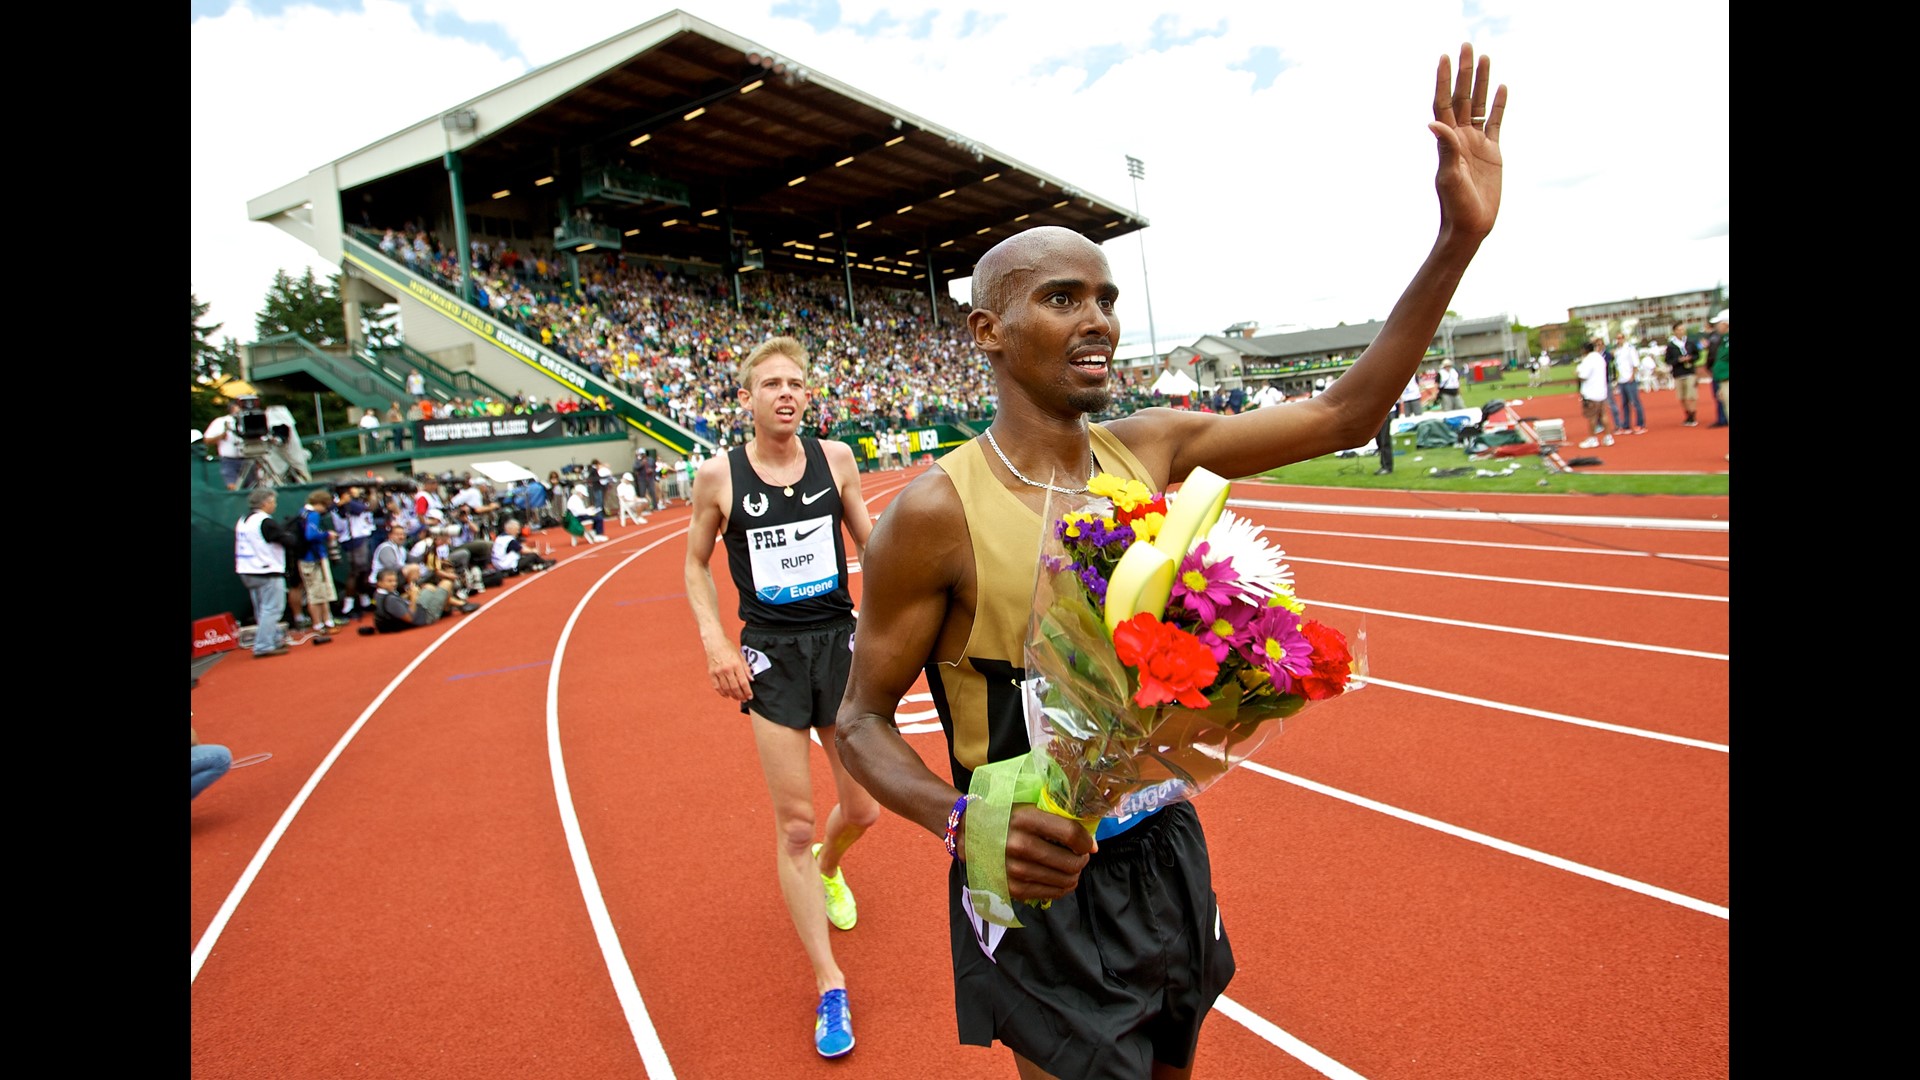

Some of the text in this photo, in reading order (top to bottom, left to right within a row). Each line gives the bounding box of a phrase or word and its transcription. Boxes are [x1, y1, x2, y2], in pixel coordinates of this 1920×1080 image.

[461, 310, 494, 336] FIELD
[496, 329, 538, 361] EUGENE
[539, 355, 587, 389] OREGON
[492, 419, 529, 436] CLASSIC
[919, 429, 938, 451] USA
[753, 528, 787, 550] PRE
[781, 553, 815, 570] RUPP
[789, 580, 833, 598] Eugene
[193, 634, 232, 649] OMEGA
[1117, 778, 1182, 825] Eugen
